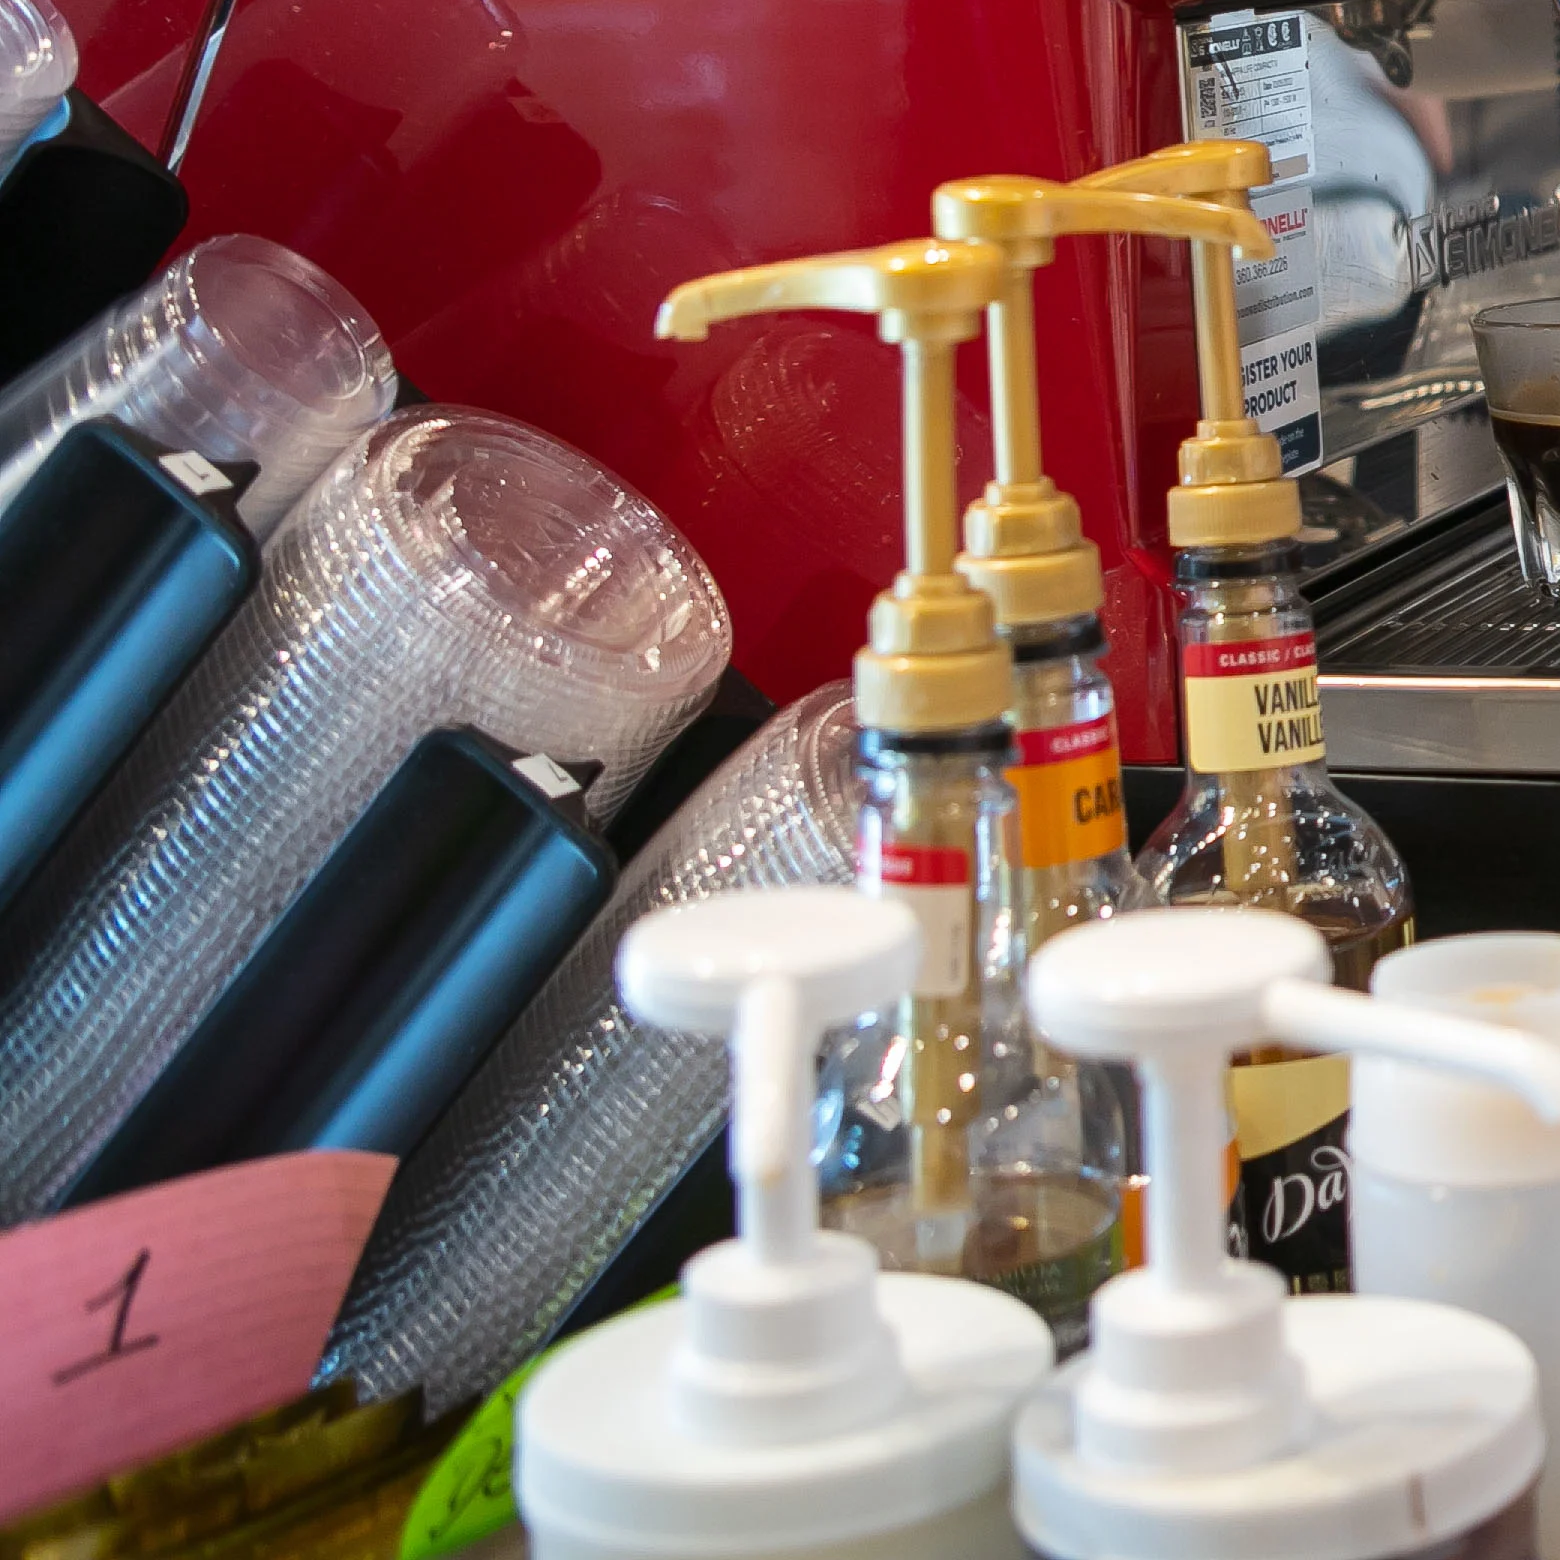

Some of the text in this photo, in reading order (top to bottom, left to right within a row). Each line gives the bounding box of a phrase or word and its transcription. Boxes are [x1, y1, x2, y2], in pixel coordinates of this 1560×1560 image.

[1240, 342, 1313, 387] GISTER YOUR
[1219, 648, 1281, 667] CLASSIC
[53, 1247, 160, 1387] 1
